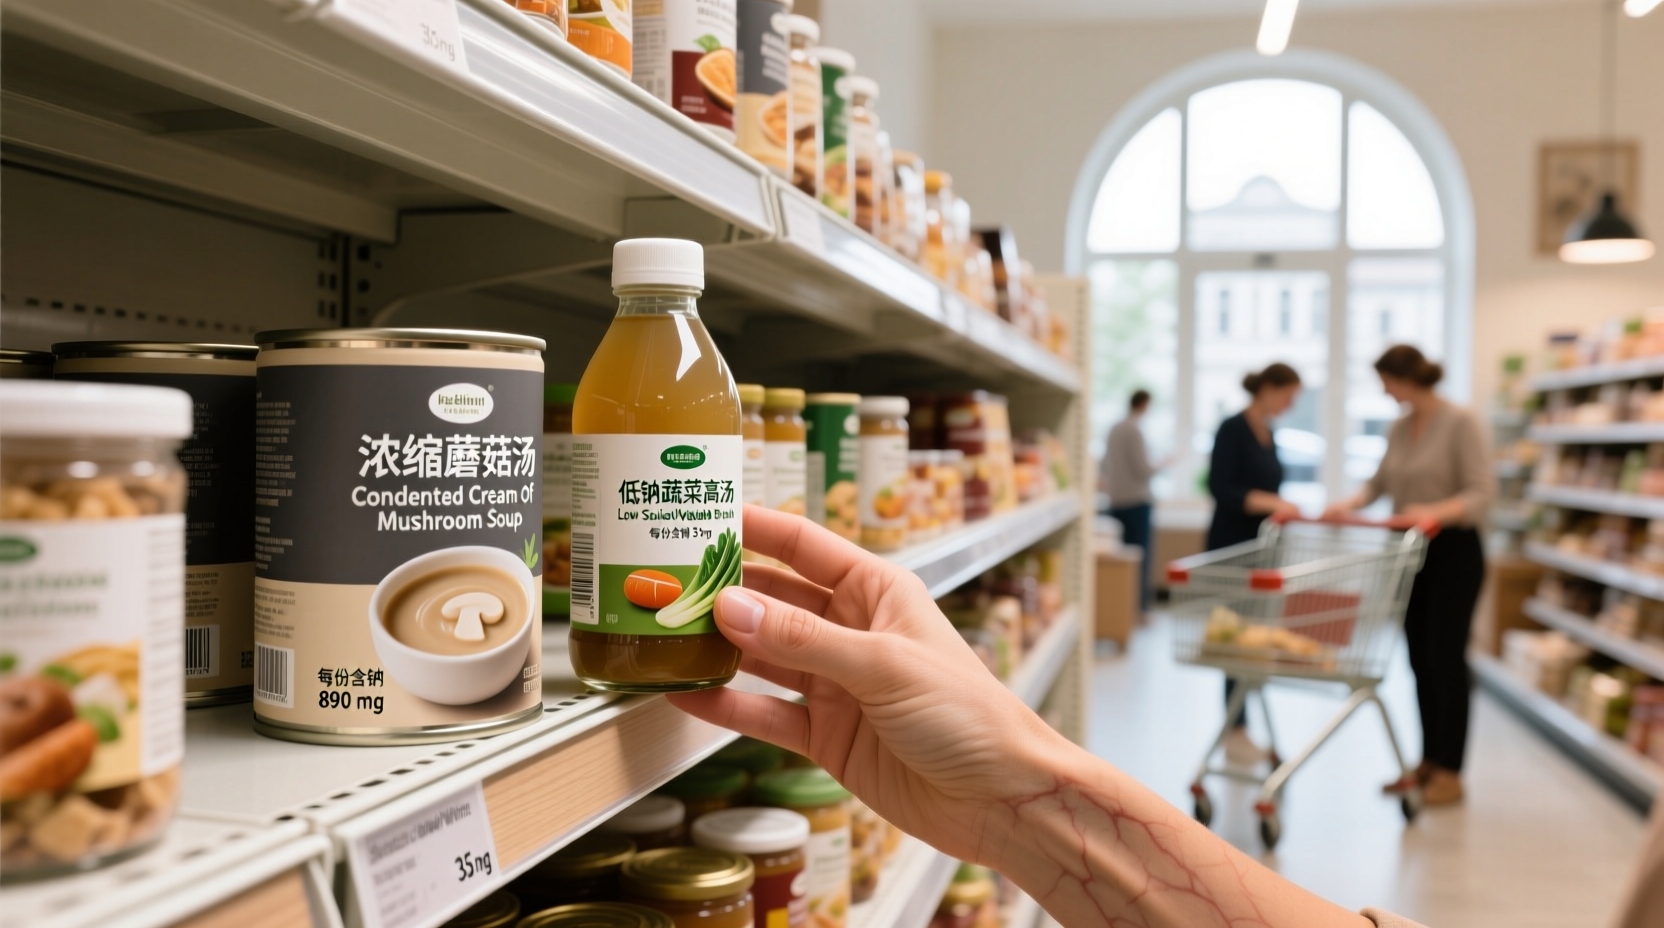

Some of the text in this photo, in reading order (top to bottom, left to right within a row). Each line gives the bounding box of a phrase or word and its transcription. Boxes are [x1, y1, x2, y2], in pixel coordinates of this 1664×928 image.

[357, 433, 536, 479] 浓缩蘑菇汤
[351, 485, 464, 507] Condented
[468, 485, 518, 505] Cream
[377, 508, 523, 533] Mushroom Soup
[317, 667, 385, 688] 每份含钠
[318, 691, 385, 715] 890 mg
